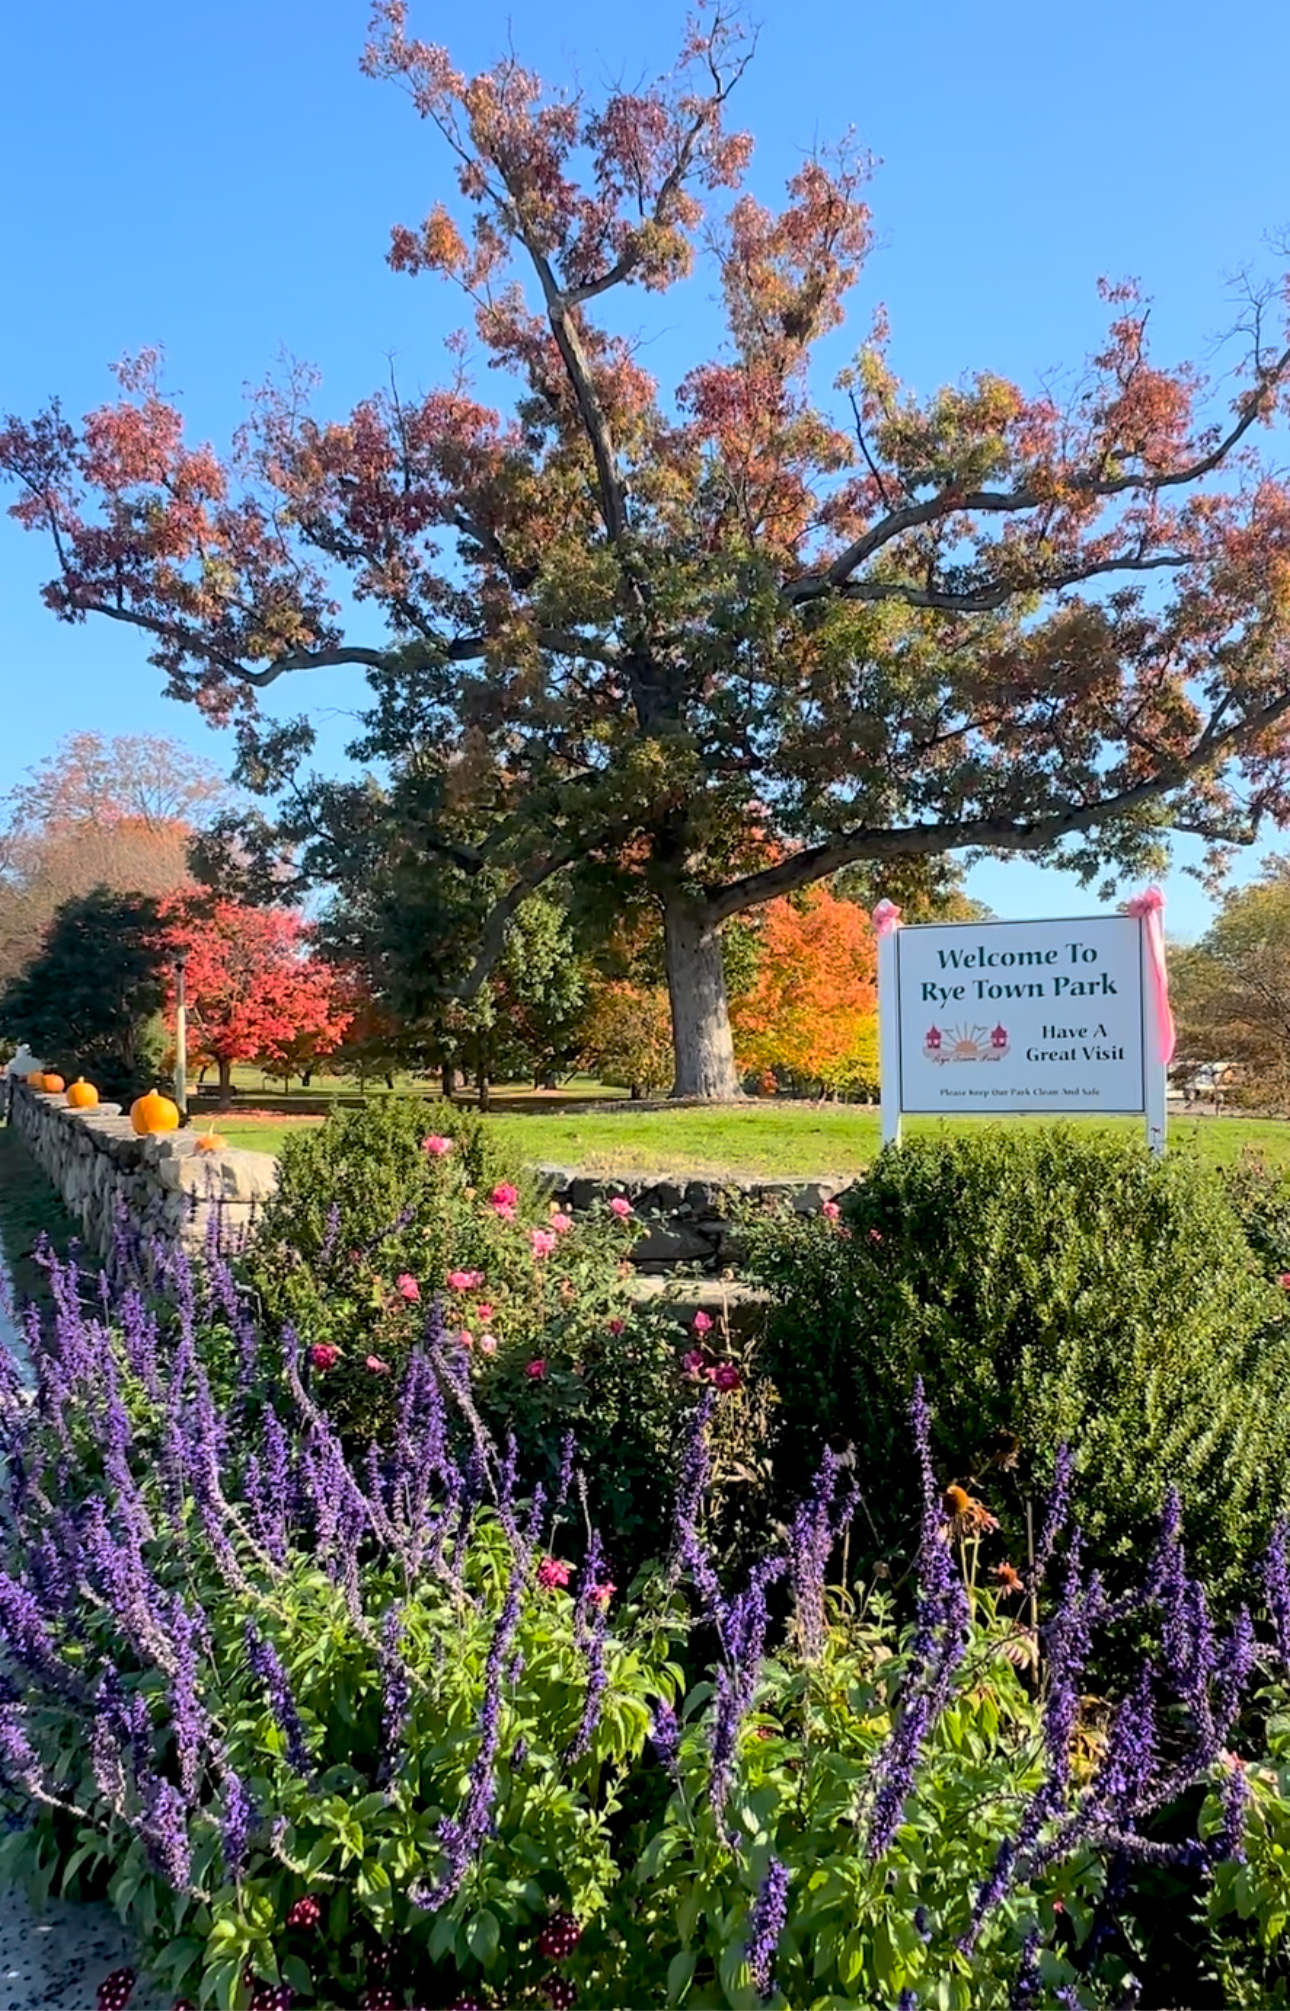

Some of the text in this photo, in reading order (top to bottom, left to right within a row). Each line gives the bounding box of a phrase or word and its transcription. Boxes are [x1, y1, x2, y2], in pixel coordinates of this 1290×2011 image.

[937, 943, 1098, 969] Welcome To
[921, 973, 1118, 1008] Rye Town Park
[1042, 1023, 1107, 1039] Have A
[1026, 1046, 1125, 1062] Great Visit
[968, 1089, 989, 1098] Keep
[1011, 1088, 1030, 1096] Park
[1033, 1088, 1059, 1096] Clean
[1062, 1088, 1079, 1096] And
